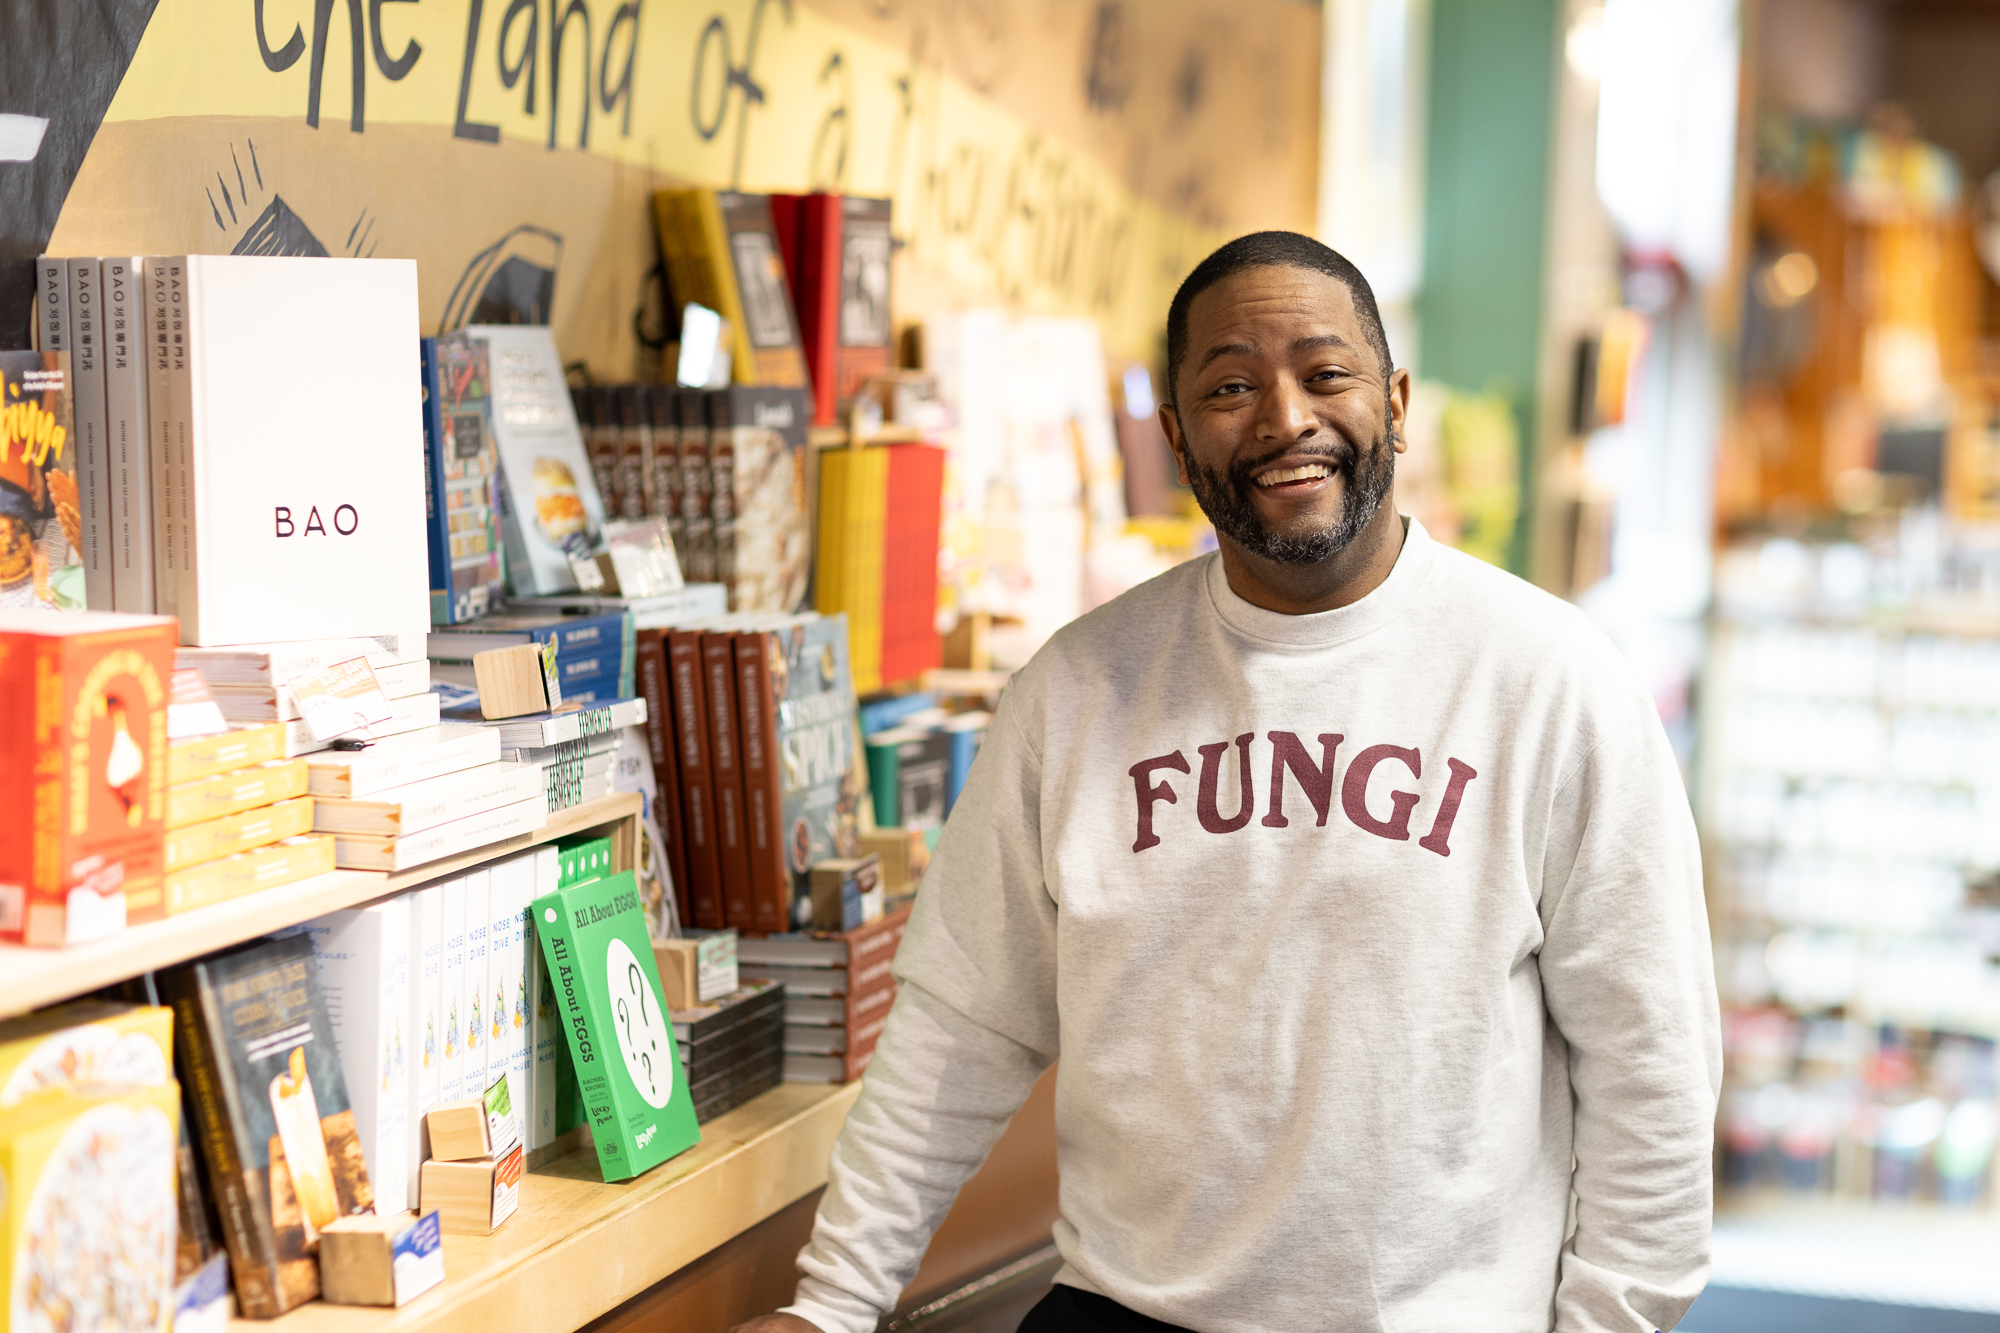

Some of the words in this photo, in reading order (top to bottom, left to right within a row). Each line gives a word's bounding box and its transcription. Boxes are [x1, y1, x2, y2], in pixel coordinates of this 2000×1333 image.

[453, 0, 645, 151] Land
[688, 0, 797, 192] of
[46, 268, 60, 304] BAO
[77, 268, 91, 304] BAO
[112, 266, 125, 302] BAO
[154, 267, 167, 303] BAO
[170, 266, 182, 303] BAO
[274, 503, 359, 538] BAO
[578, 706, 614, 738] FERMENTER
[1128, 731, 1478, 858] FUNGI
[514, 909, 533, 925] NOSE
[575, 908, 590, 929] All
[589, 901, 615, 924] About
[613, 891, 637, 914] EGGS
[469, 927, 487, 942] NOSE
[493, 918, 510, 933] NOSE
[515, 927, 532, 942] DIVE
[447, 935, 463, 950] NOSE
[470, 945, 485, 960] DIVE
[494, 936, 509, 951] DIVE
[551, 937, 568, 962] All
[447, 953, 462, 969] DIVE
[558, 961, 582, 1014] About
[537, 1036, 557, 1051] HAROLD
[572, 1015, 594, 1063] EGGS
[490, 1057, 509, 1070] HAROLD
[512, 1046, 533, 1060] HAROLD
[465, 1067, 485, 1081] HAROLD
